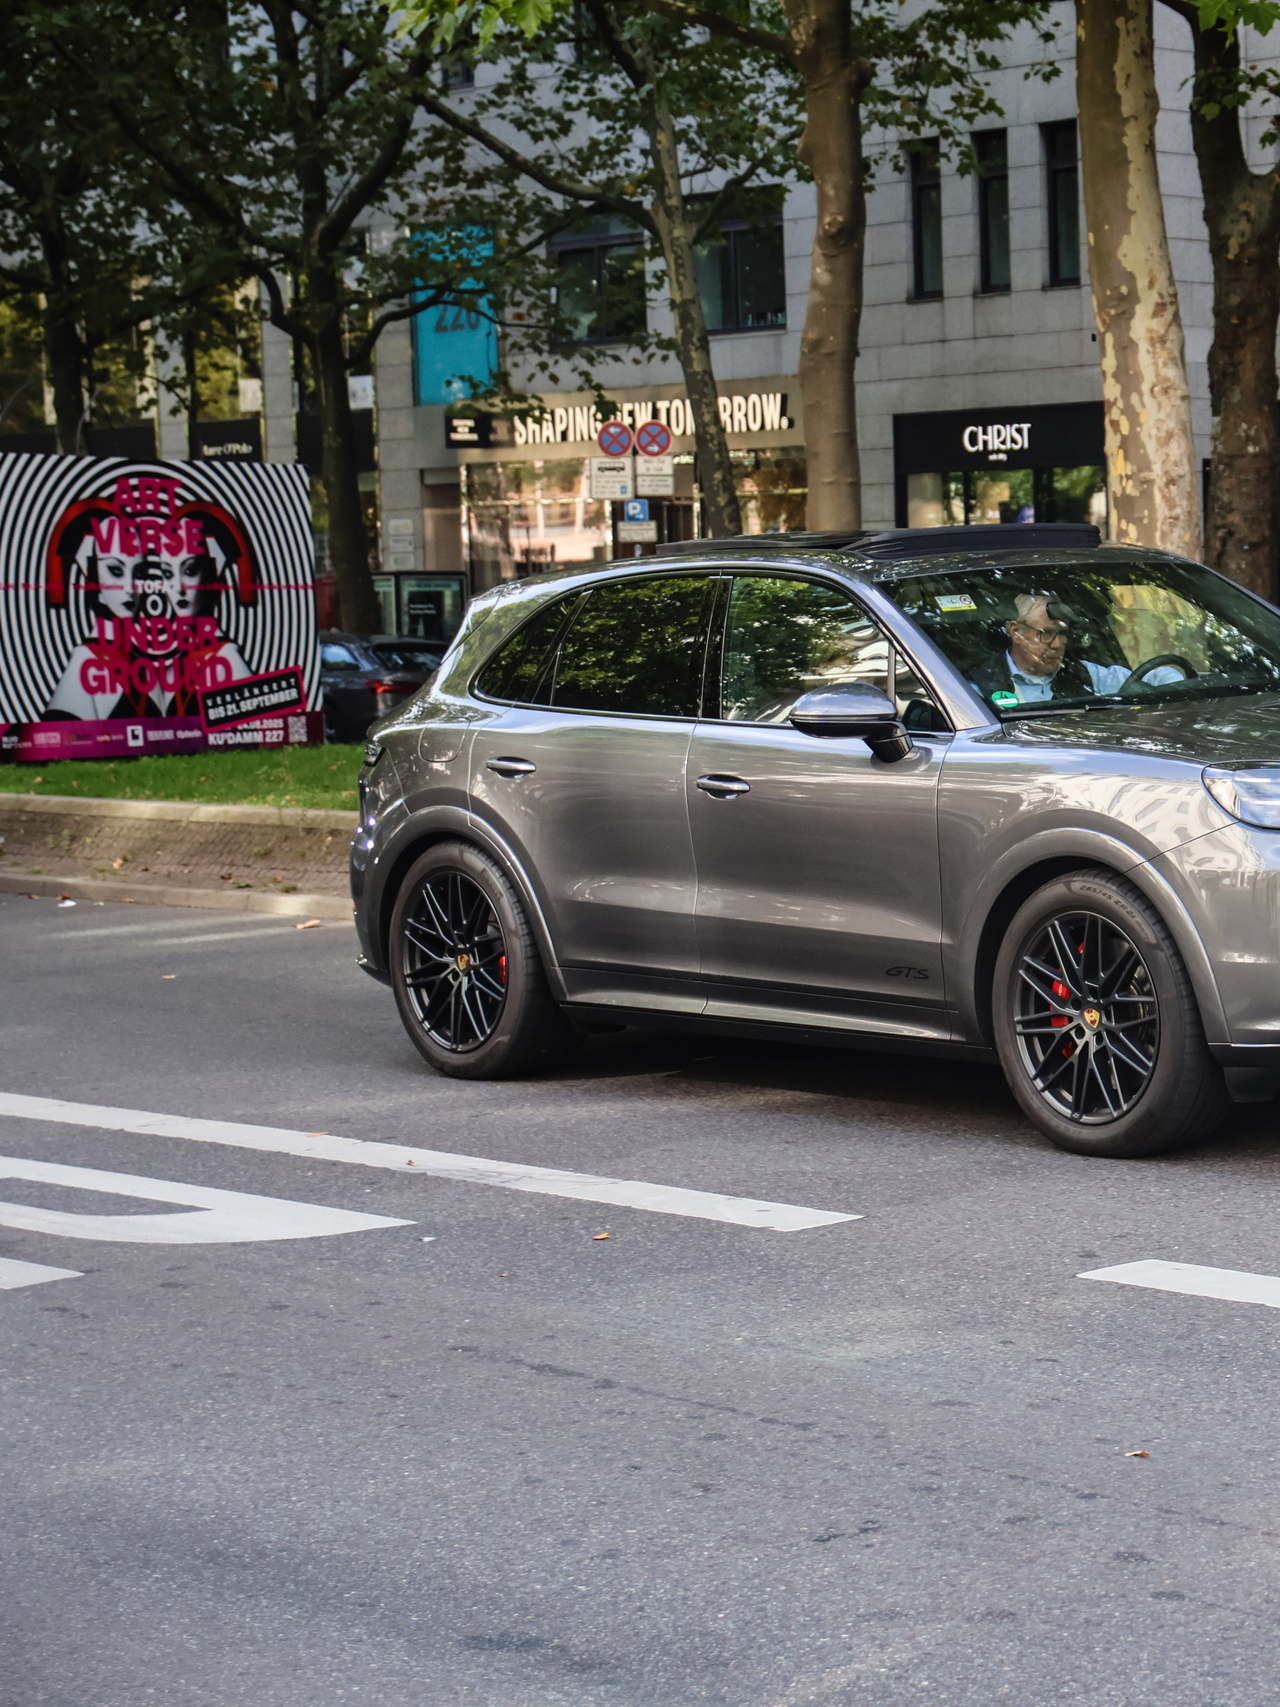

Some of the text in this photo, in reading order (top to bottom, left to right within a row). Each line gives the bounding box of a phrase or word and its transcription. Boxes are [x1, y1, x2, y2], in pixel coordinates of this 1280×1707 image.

[656, 393, 789, 437] TORROW.
[962, 423, 1032, 453] CHRIST
[112, 477, 182, 515] ART
[628, 502, 641, 517] P
[90, 517, 205, 557] VERSE
[97, 616, 219, 652] UNDER
[79, 655, 233, 696] GROUND
[208, 688, 299, 720] BIS 21. SEPTEMBER
[208, 731, 264, 745] KU'DAMM
[265, 730, 285, 743] 227
[886, 966, 930, 980] GTS
